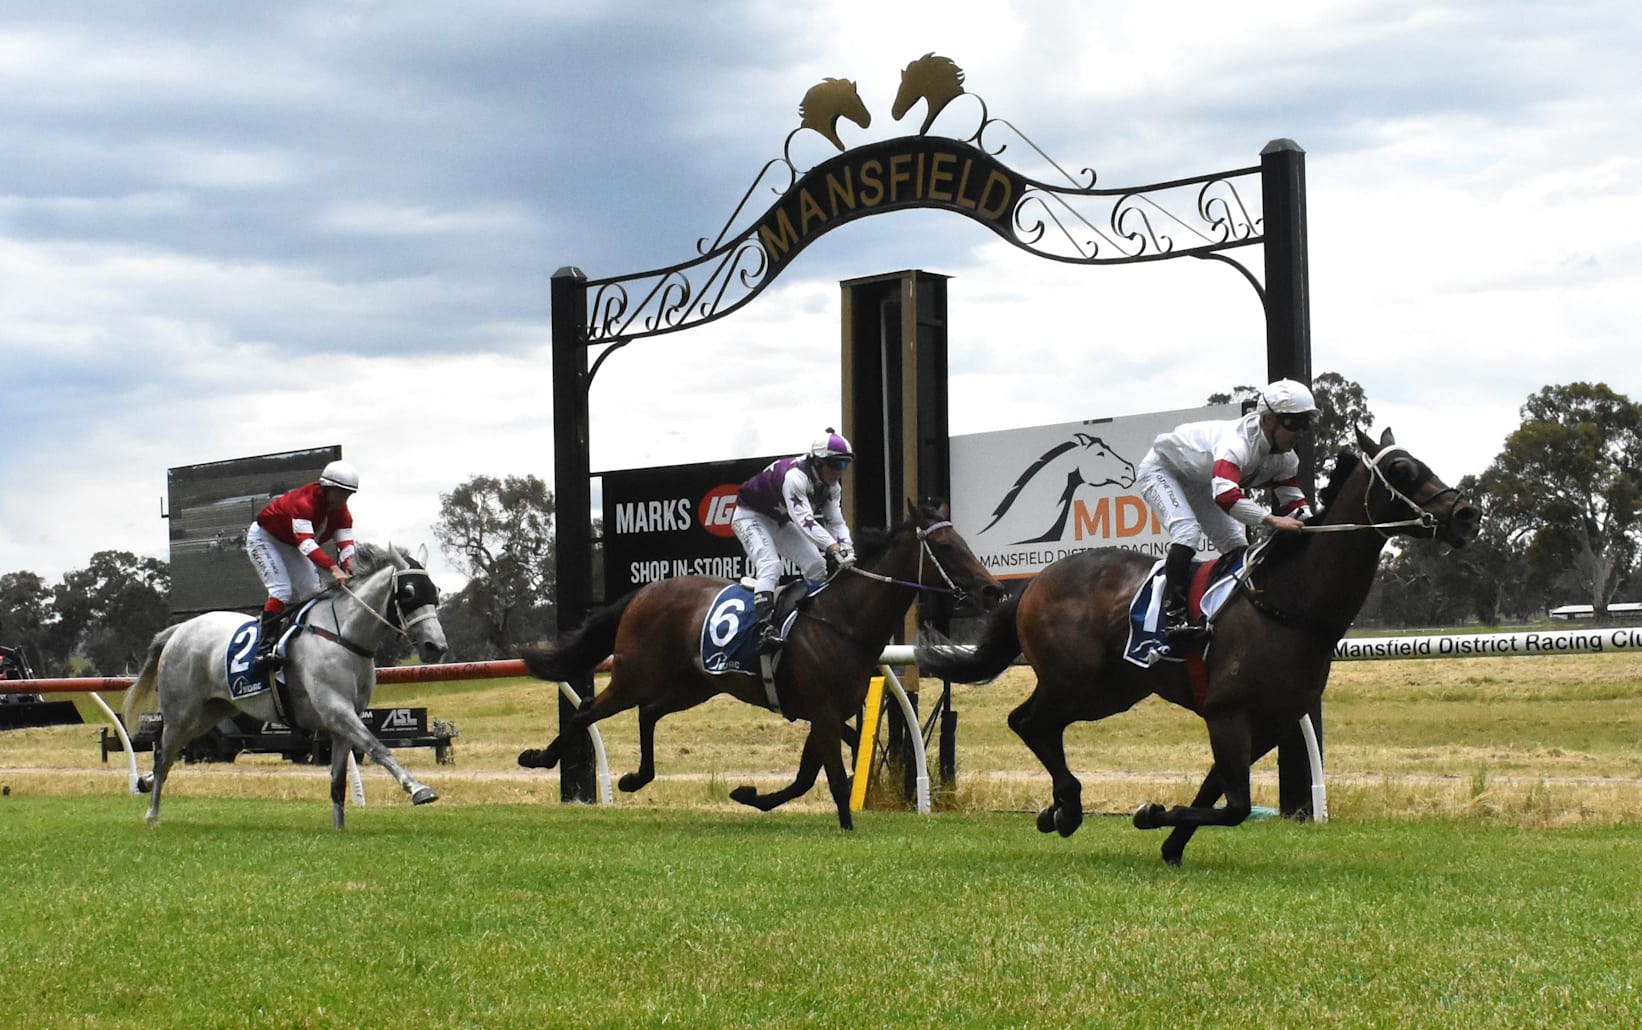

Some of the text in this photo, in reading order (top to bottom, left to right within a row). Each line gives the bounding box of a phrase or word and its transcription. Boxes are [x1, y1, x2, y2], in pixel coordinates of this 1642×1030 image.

[758, 152, 1012, 263] MANSFIELD
[615, 494, 738, 534] MARKS IG
[1073, 495, 1162, 541] MD
[630, 560, 670, 584] SHOP
[673, 556, 742, 580] IN-STORE
[980, 550, 1054, 568] MANSFIELD
[709, 598, 745, 647] 6
[230, 626, 258, 674] 2
[1332, 638, 1432, 658] Mansfield
[1440, 634, 1519, 654] District
[1525, 632, 1603, 652] Racing
